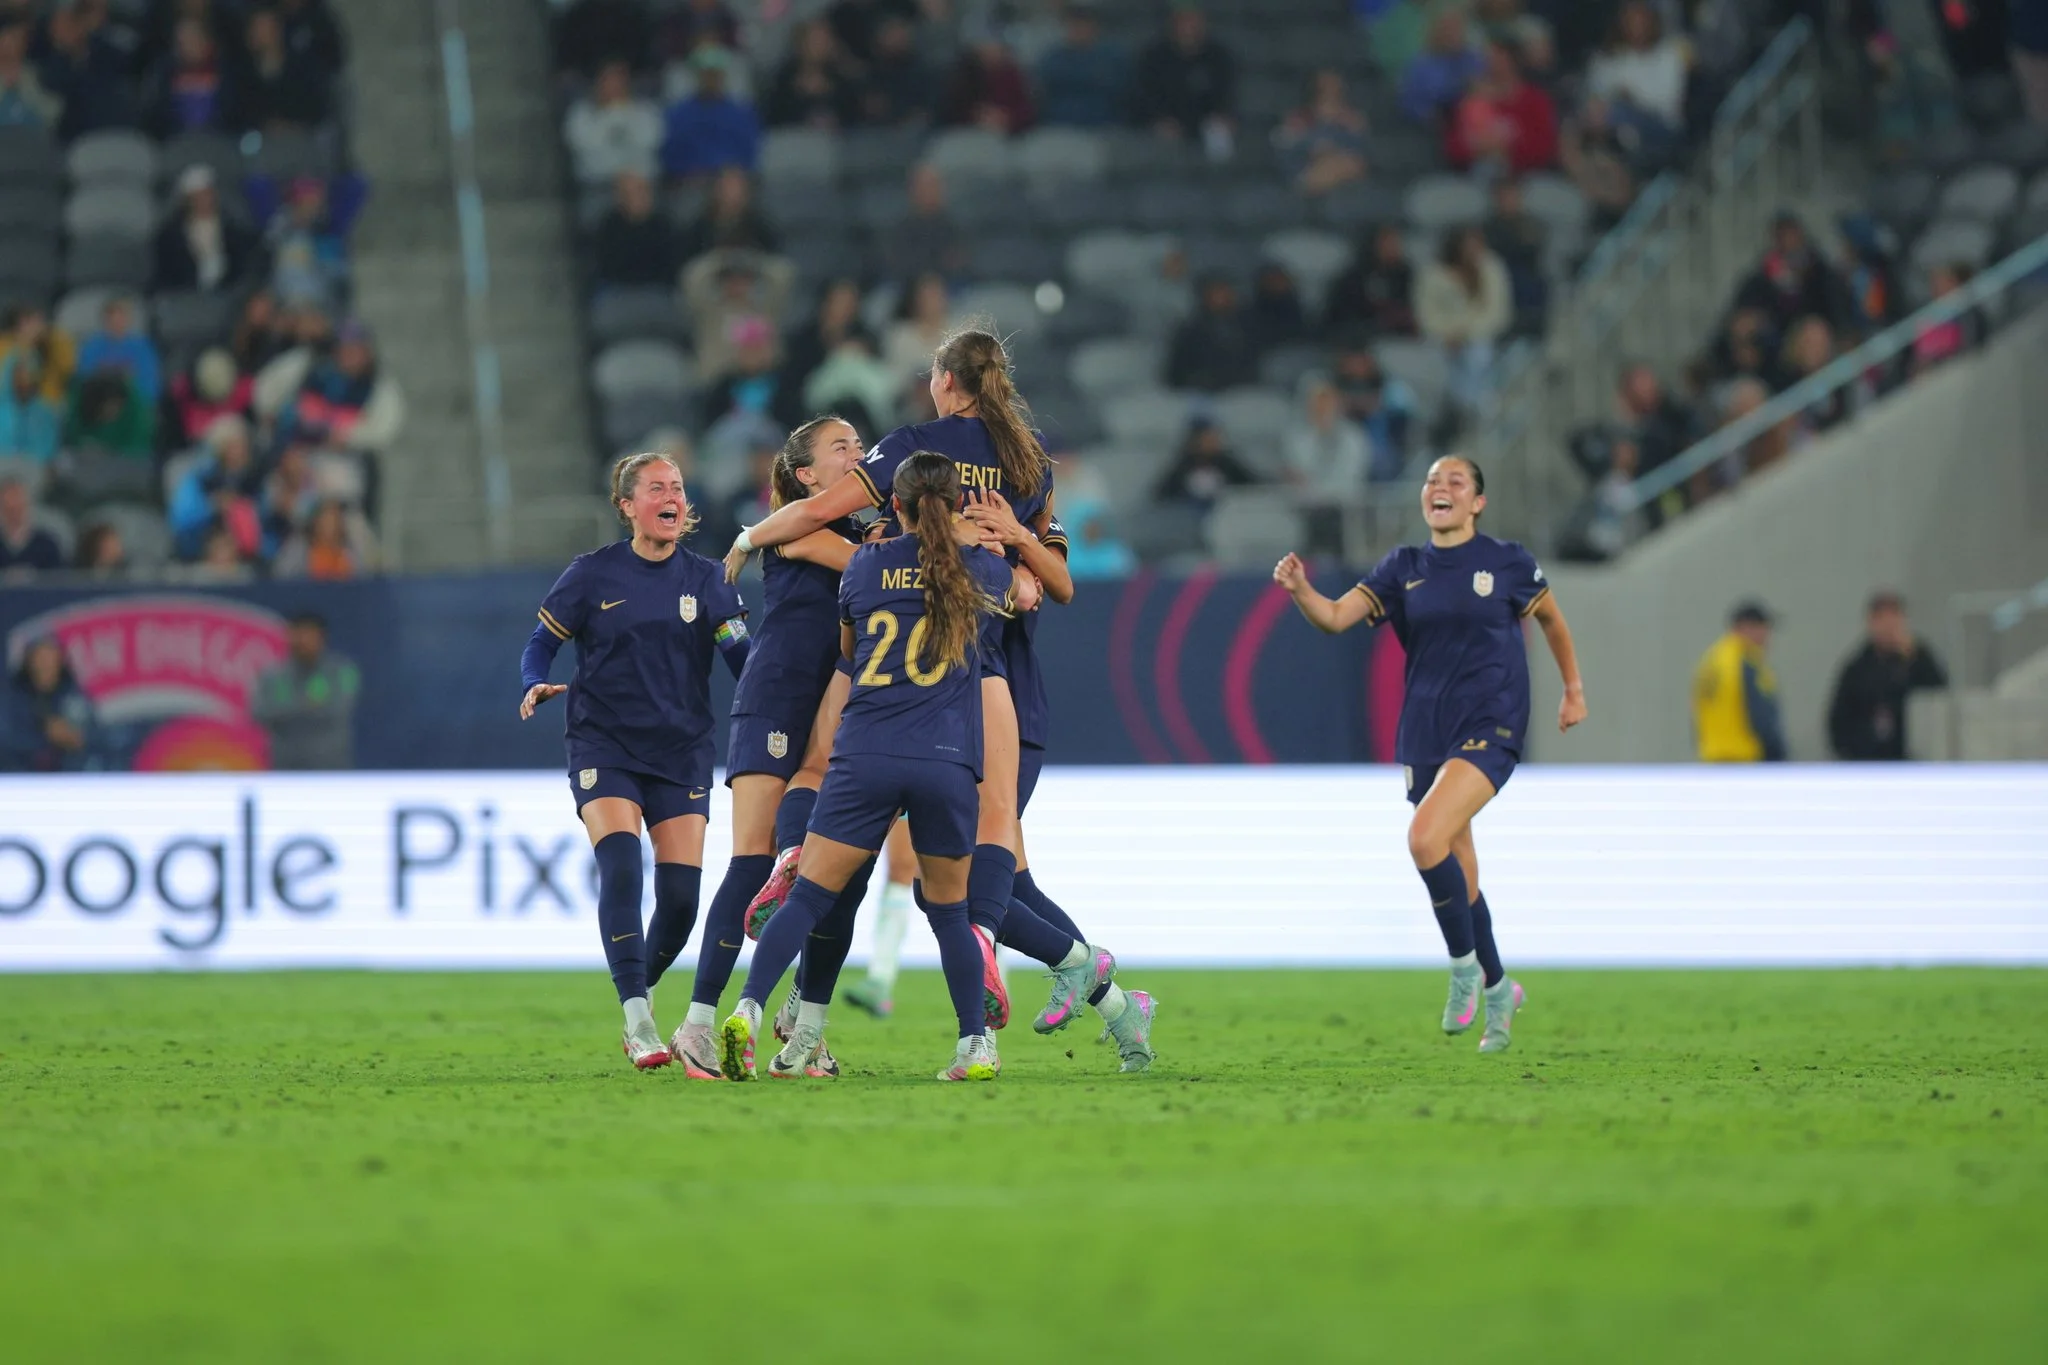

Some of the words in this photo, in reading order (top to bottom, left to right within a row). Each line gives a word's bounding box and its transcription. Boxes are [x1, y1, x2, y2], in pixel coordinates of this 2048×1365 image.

[866, 444, 885, 464] ly
[881, 567, 925, 590] MEZ
[0, 795, 338, 955] oogle
[391, 803, 652, 914] Pix
